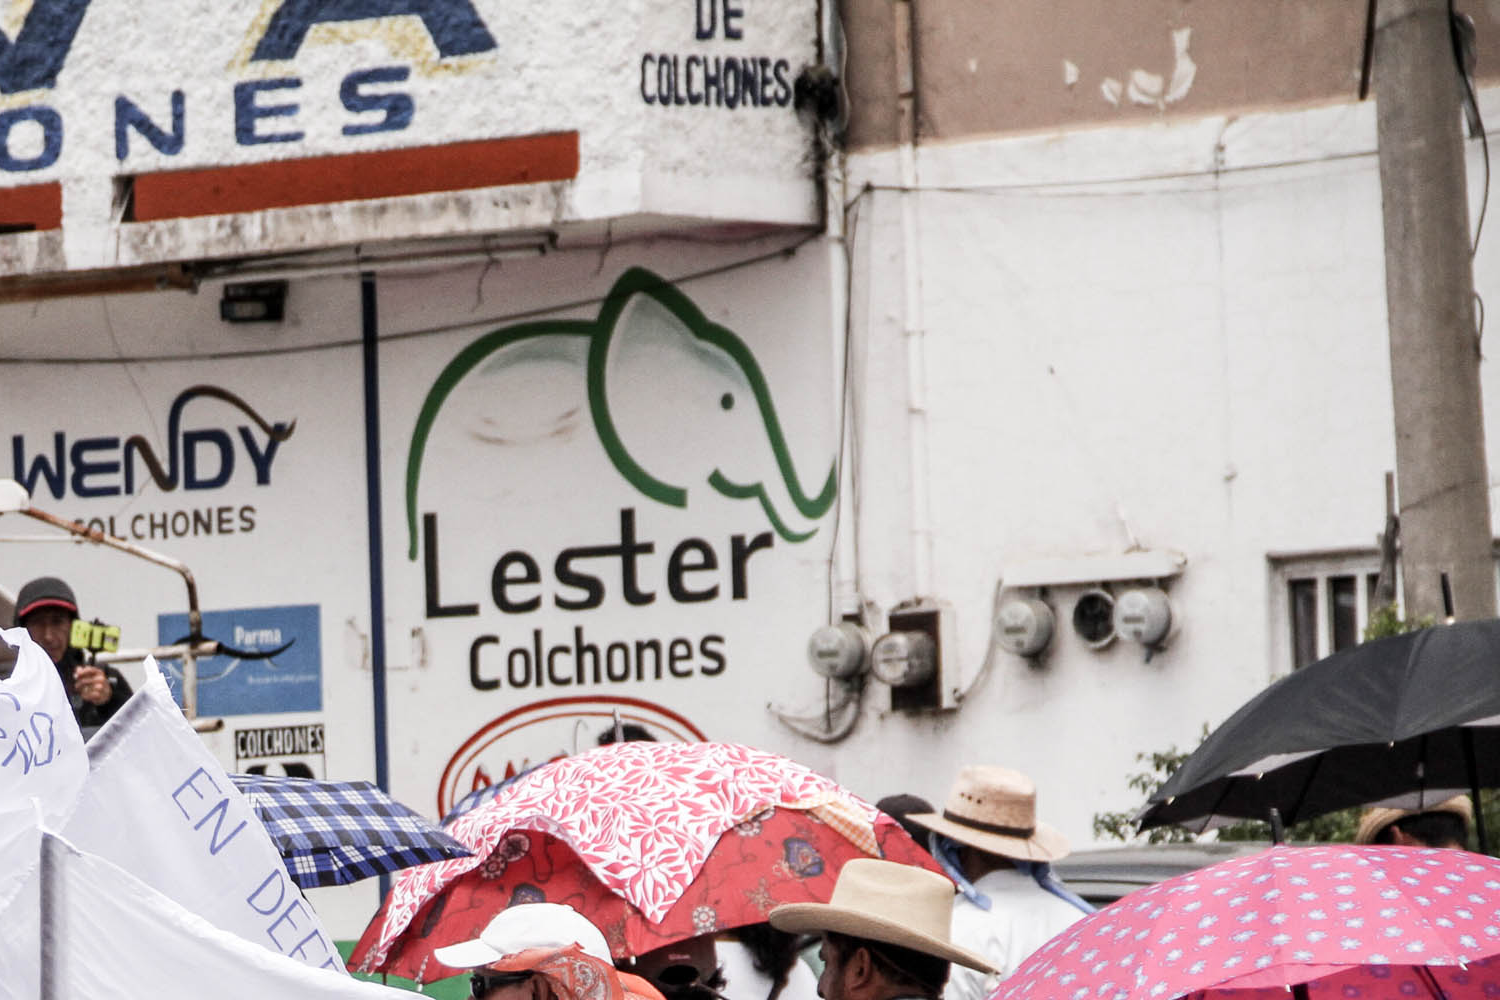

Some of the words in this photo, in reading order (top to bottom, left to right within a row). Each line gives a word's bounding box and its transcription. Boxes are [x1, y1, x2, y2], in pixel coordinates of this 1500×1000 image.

[695, 0, 744, 40] DE
[640, 53, 793, 109] COLCHONES
[11, 384, 298, 500] WENDY
[422, 507, 776, 619] Lester
[468, 625, 728, 691] Colchones
[236, 726, 326, 758] COLCHONES
[171, 766, 248, 856] EN
